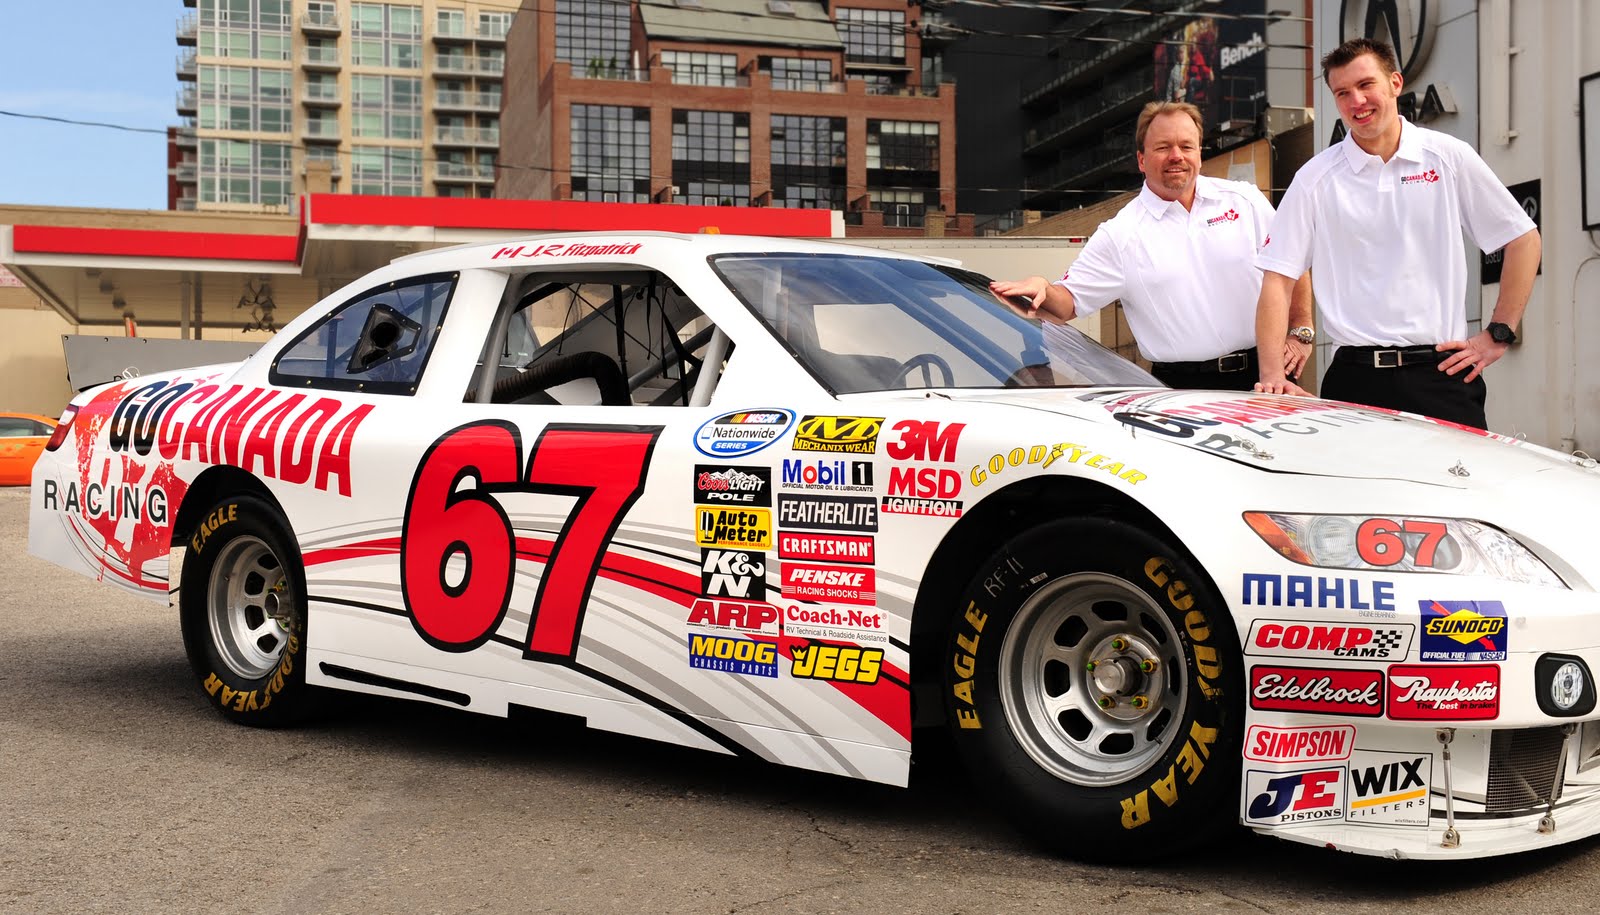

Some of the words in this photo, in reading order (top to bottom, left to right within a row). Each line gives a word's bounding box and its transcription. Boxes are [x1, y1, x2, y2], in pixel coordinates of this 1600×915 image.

[1221, 32, 1265, 69] Bench
[561, 242, 643, 257] Fitzpatrick
[744, 413, 782, 424] NASCAR
[712, 427, 775, 439] Nationwide
[886, 419, 967, 463] 3M
[715, 442, 748, 450] SERIES
[794, 438, 844, 452] MECHANIX
[846, 441, 875, 453] WEAR
[697, 472, 729, 491] Coors
[729, 479, 765, 491] LIGHT
[782, 459, 845, 485] Mobil
[855, 462, 868, 485] 1
[887, 467, 962, 499] MSD
[43, 479, 168, 523] RACING
[707, 492, 755, 502] POLE
[887, 498, 957, 516] IGNITION
[717, 510, 758, 527] Auto
[780, 500, 875, 526] FEATHERLITE
[192, 504, 238, 554] EAGLE
[713, 526, 767, 543] Meter
[400, 419, 666, 665] 67
[783, 537, 868, 557] CRAFTSMAN
[1356, 518, 1448, 567] 67
[789, 568, 866, 587] PENSKE
[796, 586, 825, 597] RACING
[827, 588, 858, 599] SHOCKS
[1242, 573, 1395, 611] MAHLE
[687, 600, 777, 630] ARP
[787, 605, 881, 629] Coach-Net
[1429, 619, 1502, 633] SUNOCO
[786, 626, 795, 635] RV
[796, 627, 822, 637] Technical
[822, 629, 827, 637] &
[828, 629, 855, 639] Roadside
[856, 632, 887, 643] Assistance
[1255, 624, 1373, 651] COMP
[691, 635, 776, 665] MOOG
[1333, 647, 1390, 657] CAMS
[1423, 651, 1450, 659] OFFICIAL
[1451, 651, 1466, 659] FUEL
[694, 657, 735, 672] CHASSIS
[741, 662, 773, 677] PARTS
[792, 645, 884, 682] JEGS
[953, 600, 988, 729] EAGLE
[1253, 673, 1379, 706] Edelbrock
[1389, 676, 1497, 709] Raybestos
[1253, 730, 1347, 758] SIMPSON
[1351, 757, 1425, 797] WIX
[1248, 771, 1340, 819] JE
[1280, 808, 1342, 823] PISTONS
[1350, 799, 1426, 818] FILTERS
